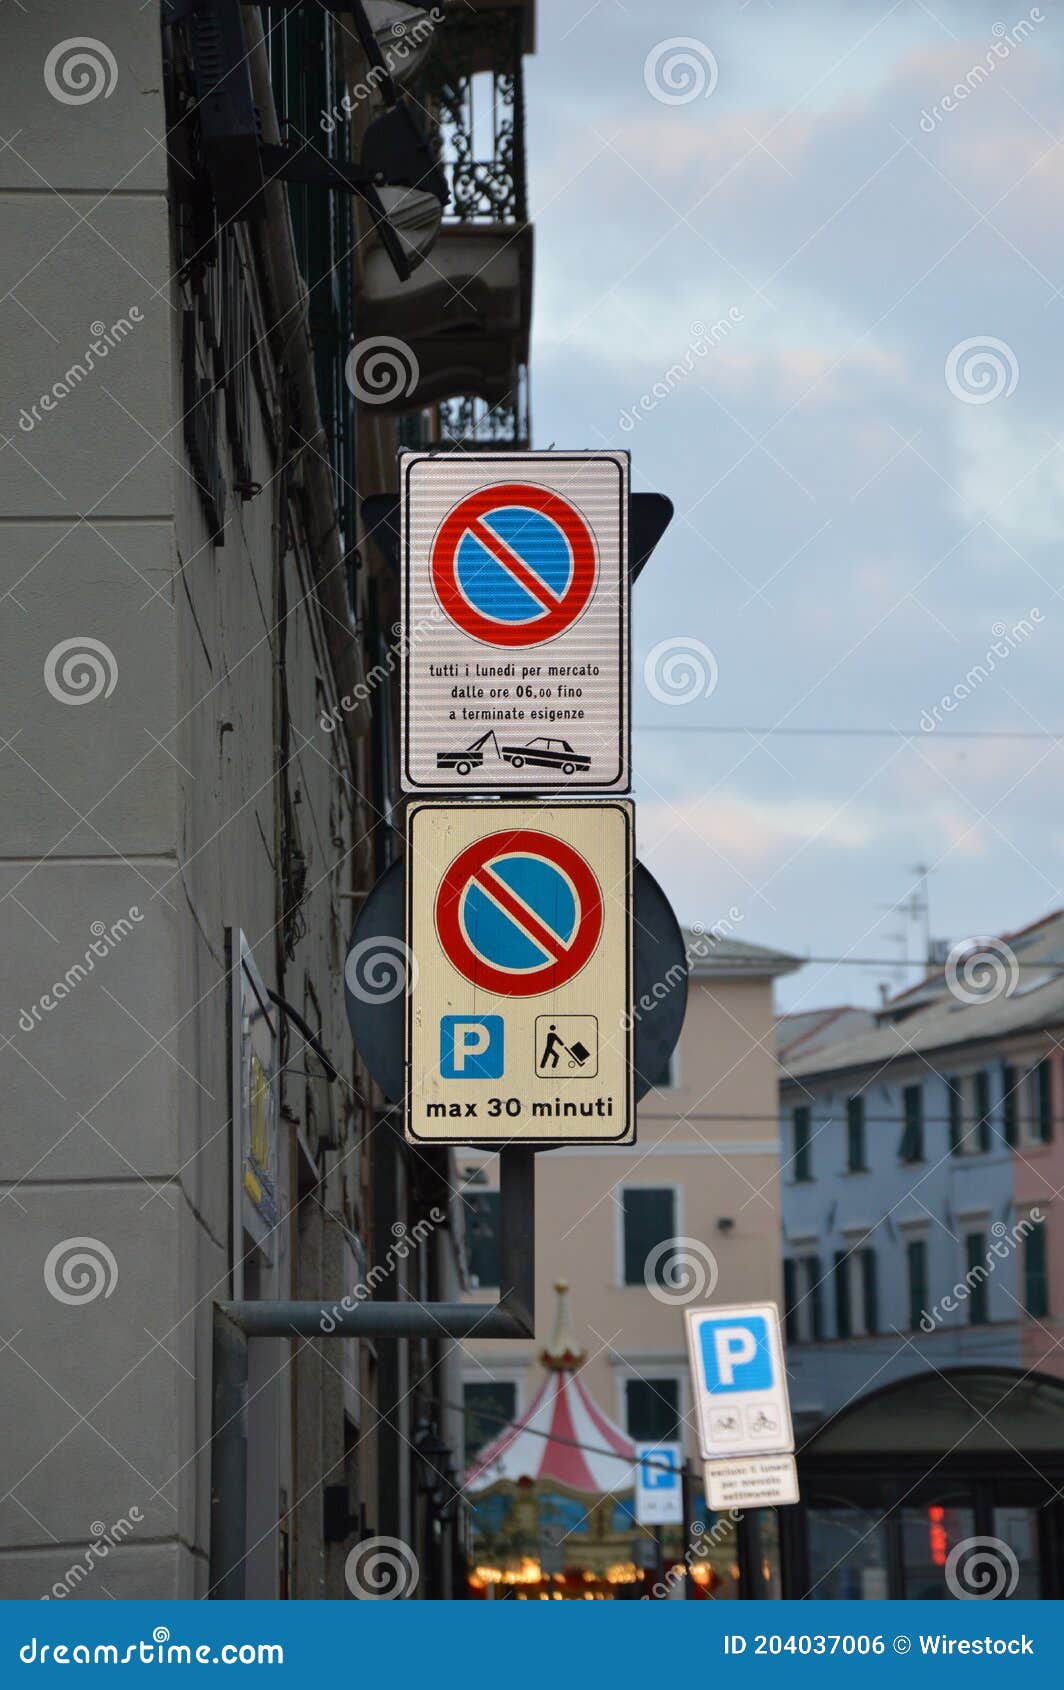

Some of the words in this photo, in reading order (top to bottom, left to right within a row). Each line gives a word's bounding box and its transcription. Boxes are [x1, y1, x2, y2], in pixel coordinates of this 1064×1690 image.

[429, 664, 459, 677] tutti
[465, 664, 470, 677] i
[476, 664, 516, 677] lunedi
[522, 667, 542, 680] per
[548, 664, 600, 677] mercato
[451, 686, 484, 698] dalle
[490, 689, 509, 698] ore
[558, 685, 583, 698] fino
[449, 711, 456, 720] a
[463, 708, 525, 720] terminate
[531, 708, 585, 721] esigenze
[454, 1024, 490, 1071] P
[426, 1103, 478, 1118] max
[487, 1098, 521, 1118] 30
[532, 1097, 613, 1117] minuti
[714, 1327, 757, 1385] P
[648, 1453, 671, 1486] P
